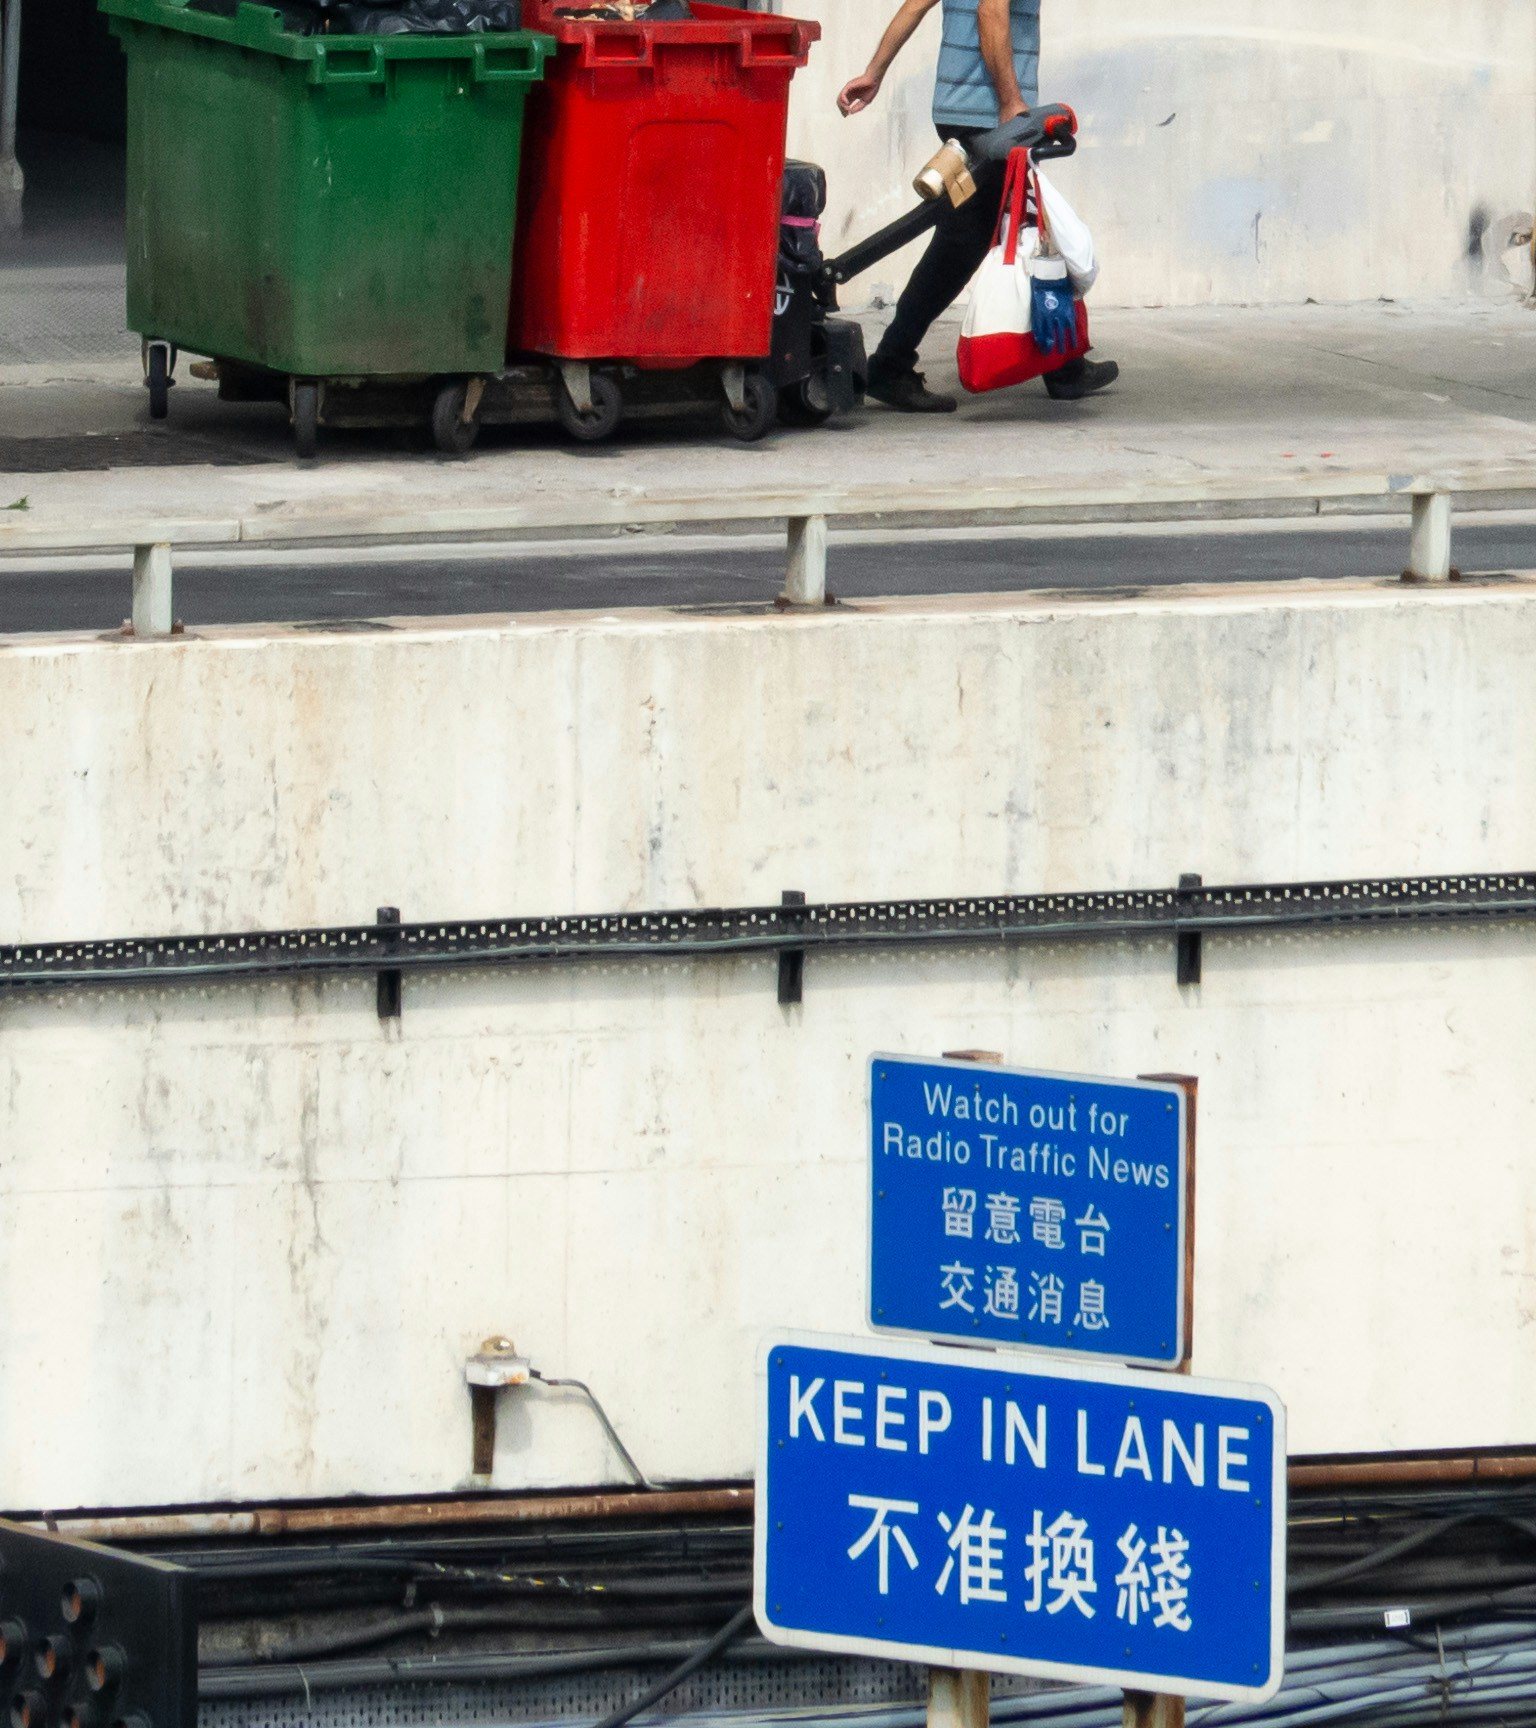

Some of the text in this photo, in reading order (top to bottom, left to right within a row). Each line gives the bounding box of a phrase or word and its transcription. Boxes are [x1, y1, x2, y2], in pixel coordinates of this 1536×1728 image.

[923, 1082, 1129, 1137] Watch out for
[883, 1122, 1170, 1188] Radio Traffic News
[941, 1186, 1111, 1257] 留意電台
[939, 1260, 1110, 1330] 交通消息
[789, 1375, 1250, 1493] KEEP IN LANE
[847, 1494, 1192, 1632] 不准換綫
